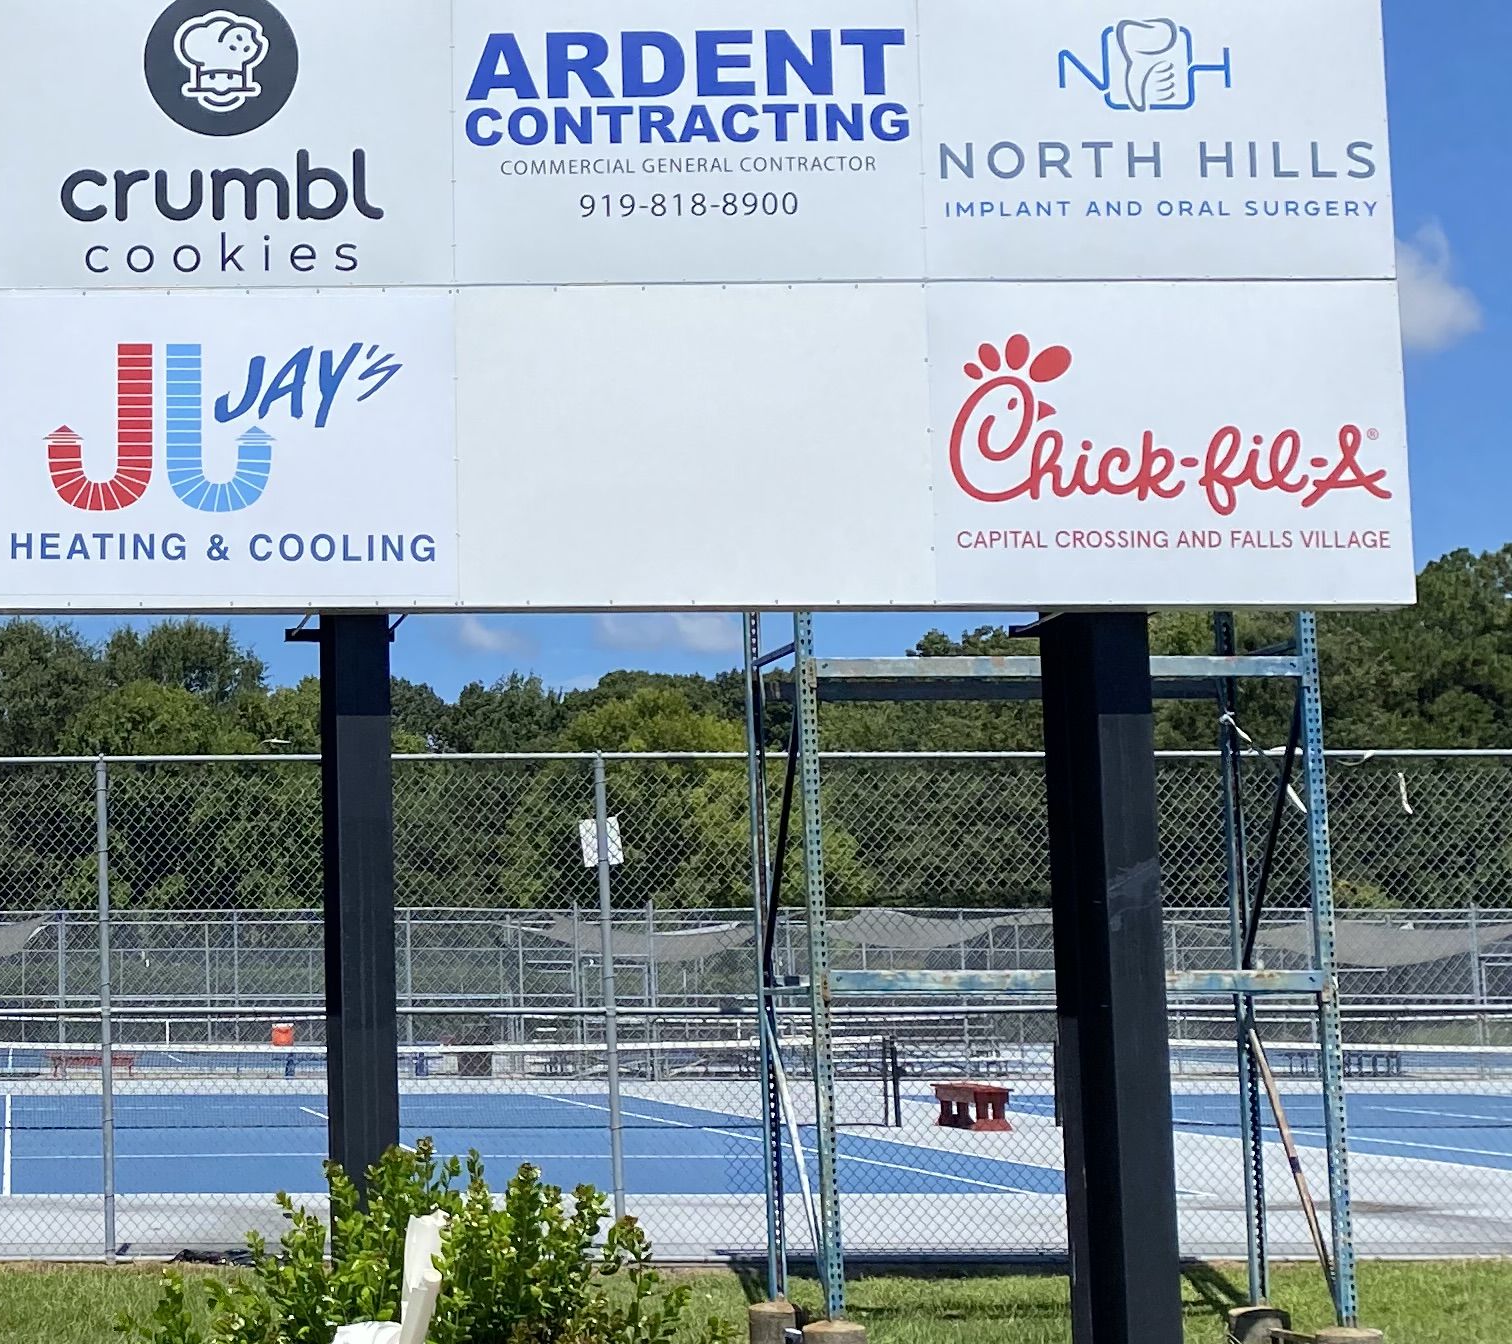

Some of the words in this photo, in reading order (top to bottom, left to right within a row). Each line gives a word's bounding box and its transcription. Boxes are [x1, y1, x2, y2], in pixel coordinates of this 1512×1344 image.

[465, 29, 905, 101] ARDENT
[464, 103, 910, 146] CONTRACTING
[500, 158, 635, 176] COMMERCIAL
[642, 157, 733, 174] GENERAL
[740, 156, 876, 173] CONTRACTOR
[939, 141, 1162, 179] NORTH
[1199, 141, 1376, 179] HILLS
[61, 148, 384, 222] crumbl
[579, 192, 798, 218] 919-818-8900
[945, 201, 1071, 218] IMPLANT
[1086, 201, 1143, 217] AND
[1157, 201, 1231, 217] ORAL
[1245, 201, 1377, 217] SURGERY
[85, 232, 358, 273] cookies
[950, 376, 1392, 516] Chick-fil-A
[10, 532, 187, 561] HEATING
[206, 534, 230, 561] &
[249, 534, 436, 562] COOLING
[957, 530, 1048, 549] CAPITAL
[1055, 530, 1169, 549] CROSSING
[1177, 530, 1222, 549] AND
[1231, 530, 1294, 549] FALLS
[1299, 530, 1392, 549] VILLAGE
